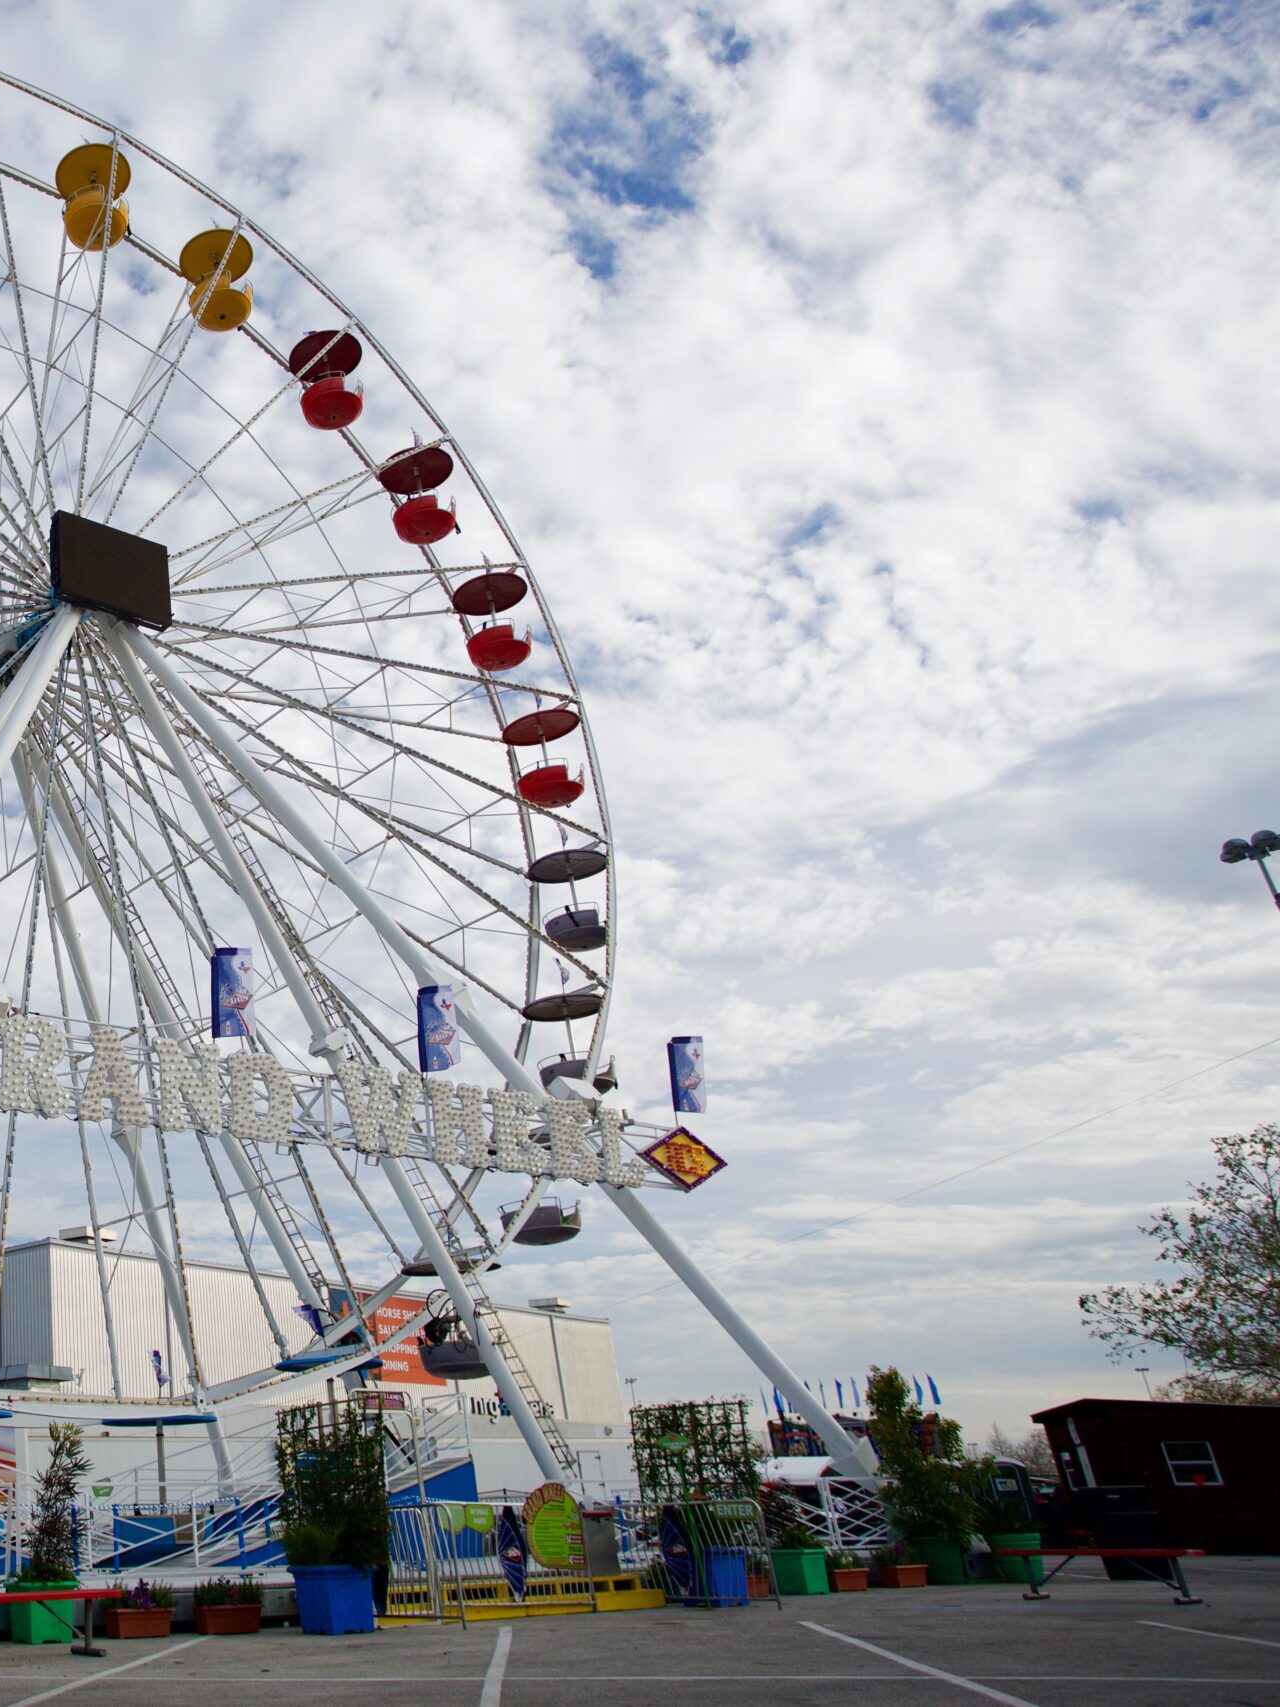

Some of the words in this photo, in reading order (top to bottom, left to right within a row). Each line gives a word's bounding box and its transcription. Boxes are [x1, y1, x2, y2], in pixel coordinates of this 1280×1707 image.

[336, 1060, 647, 1189] WHEEL
[376, 1307, 401, 1320] HORSE
[402, 1310, 417, 1320] SH
[382, 1344, 418, 1355] HOPPING
[382, 1360, 409, 1372] DINING
[717, 1504, 754, 1517] ENTER
